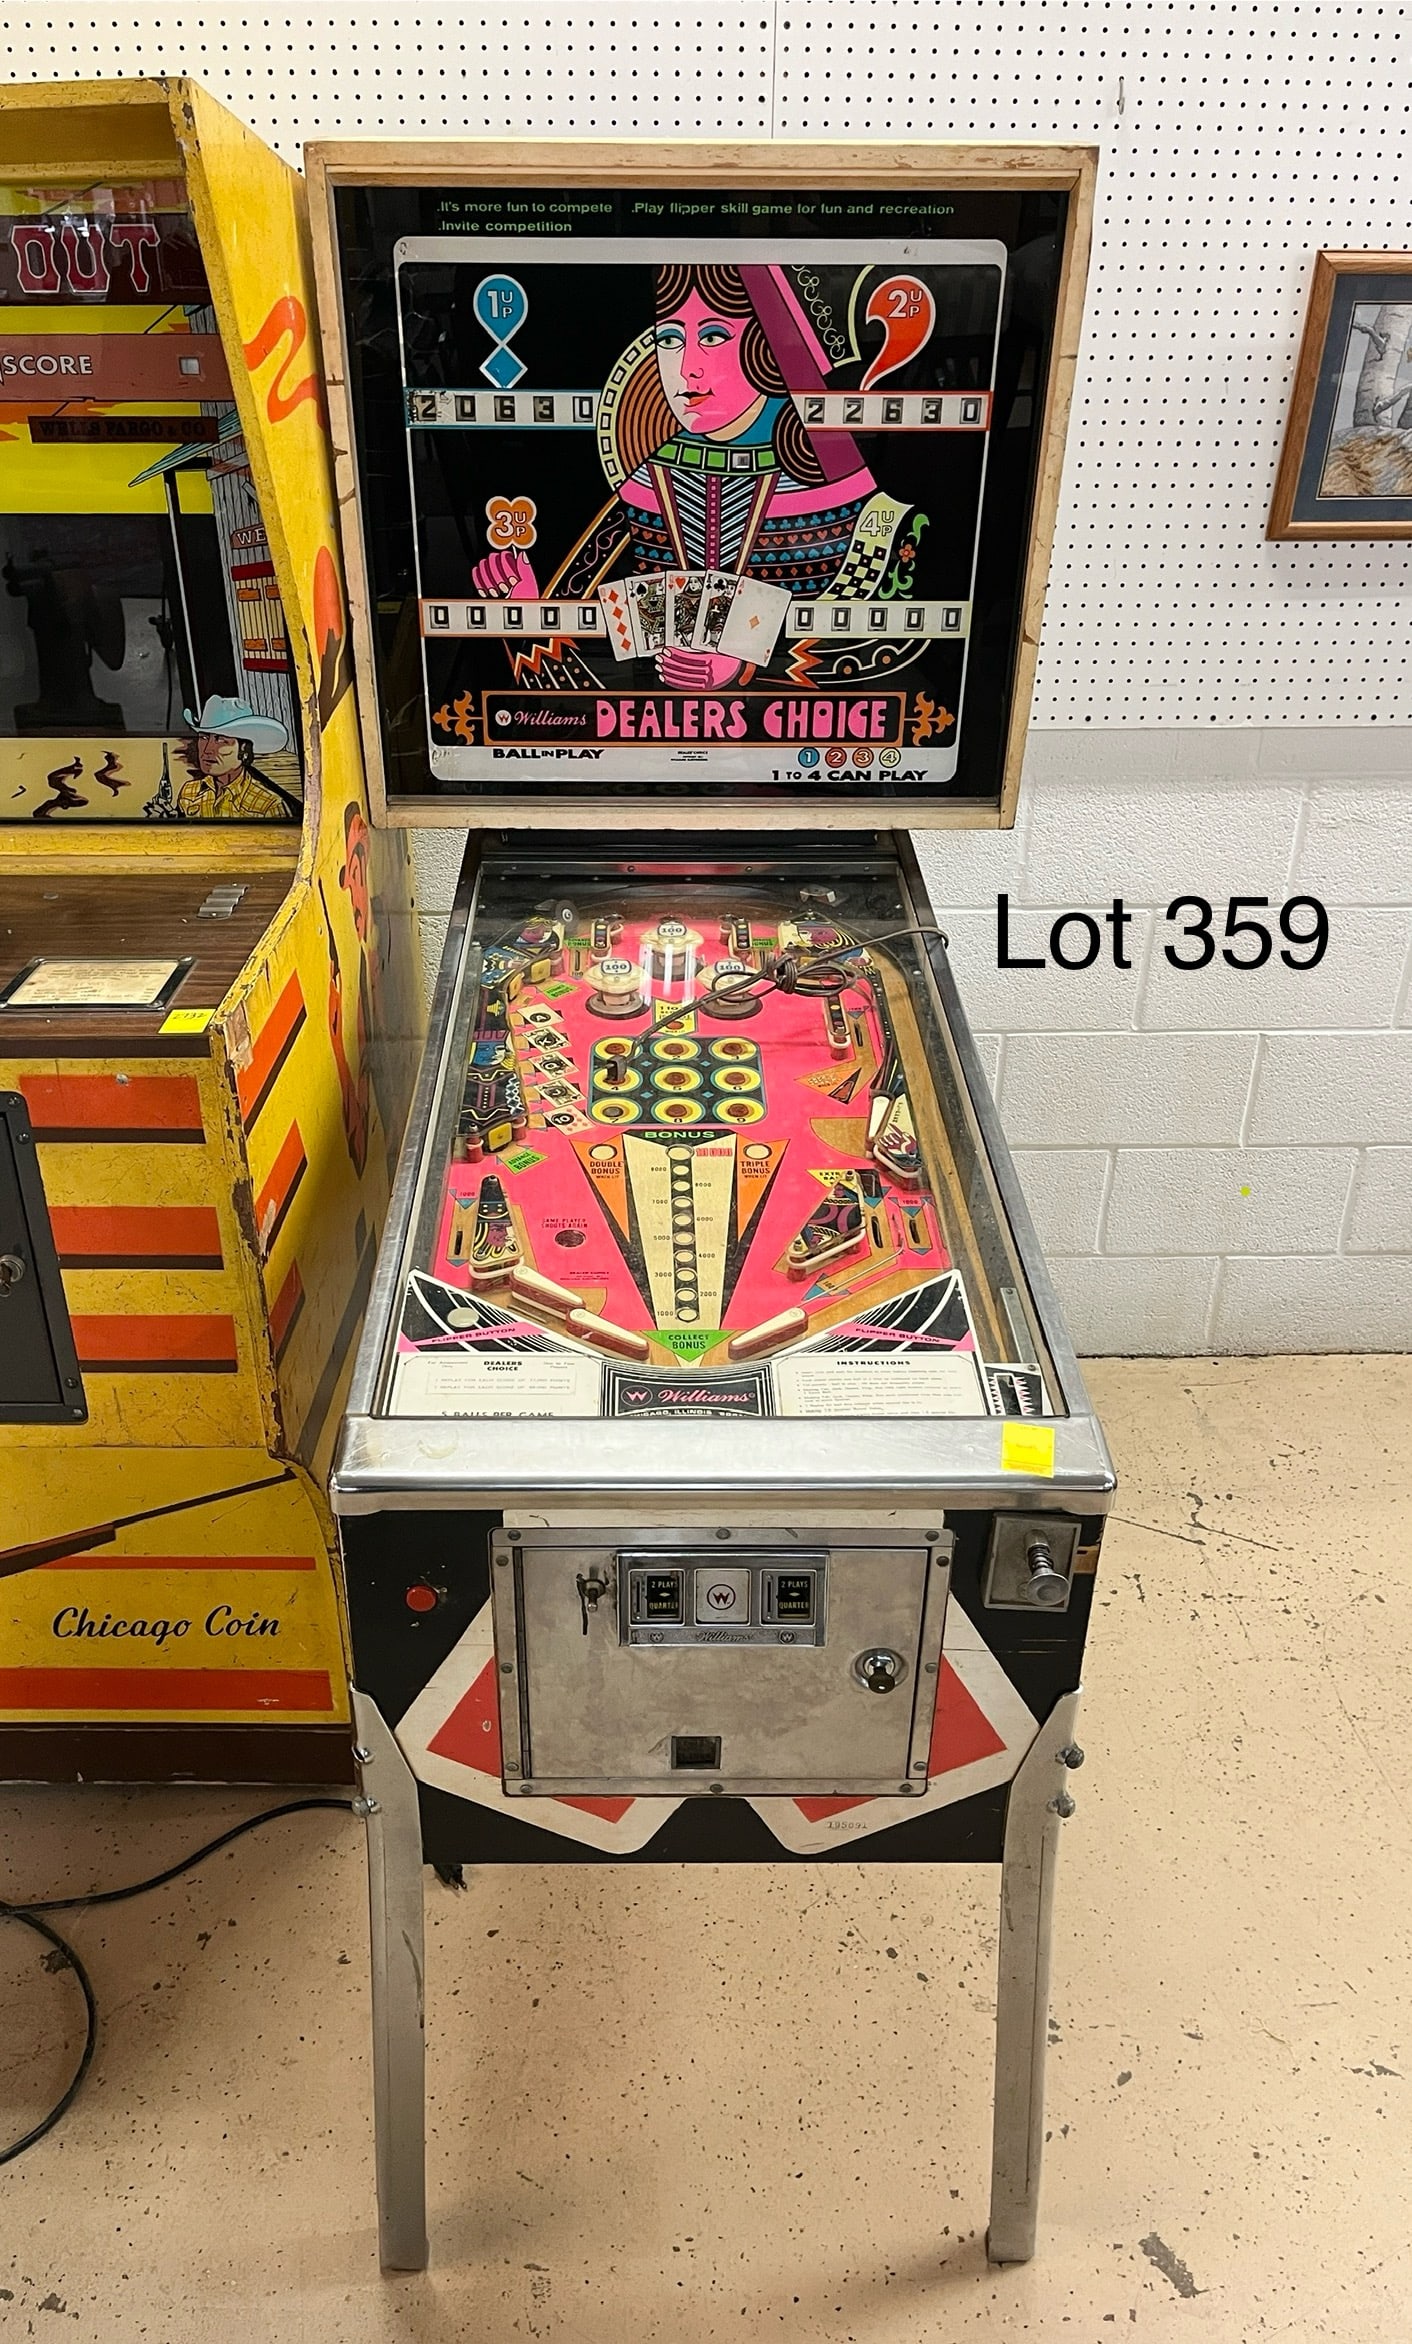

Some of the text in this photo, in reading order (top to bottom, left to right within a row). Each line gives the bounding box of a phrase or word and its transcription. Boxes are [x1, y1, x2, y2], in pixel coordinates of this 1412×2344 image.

[464, 203, 502, 213] more
[507, 201, 529, 213] fun
[532, 202, 546, 213] to
[549, 202, 613, 216] compete
[670, 202, 716, 216] flipper
[721, 202, 750, 214] skill
[752, 203, 793, 216] game
[797, 203, 817, 215] for
[820, 203, 843, 215] fun
[847, 203, 873, 215] and
[879, 203, 955, 215] recreation
[485, 221, 573, 234] competition
[11, 223, 161, 293] OUT
[1, 354, 94, 376] SCORE
[513, 709, 587, 727] Williams
[596, 700, 748, 739] DEALERS
[763, 700, 888, 739] CHOICE
[771, 769, 929, 781] 1 TO 4 CAN PLAY
[644, 1131, 716, 1139] BONUS
[513, 1154, 541, 1171] BONUS
[589, 1160, 623, 1168] DOUBLE
[740, 1160, 770, 1168] TRIPLE
[591, 1167, 621, 1175] BONUS
[741, 1167, 772, 1175] BONUS
[431, 1327, 516, 1344] FLIPPER BUTTON
[855, 1327, 941, 1344] FLIPPER BUTTON
[672, 1341, 706, 1350] BONUS
[787, 1580, 809, 1589] PLAYS
[778, 1602, 810, 1610] QUARTER
[53, 1604, 280, 1646] Chicago Coin
